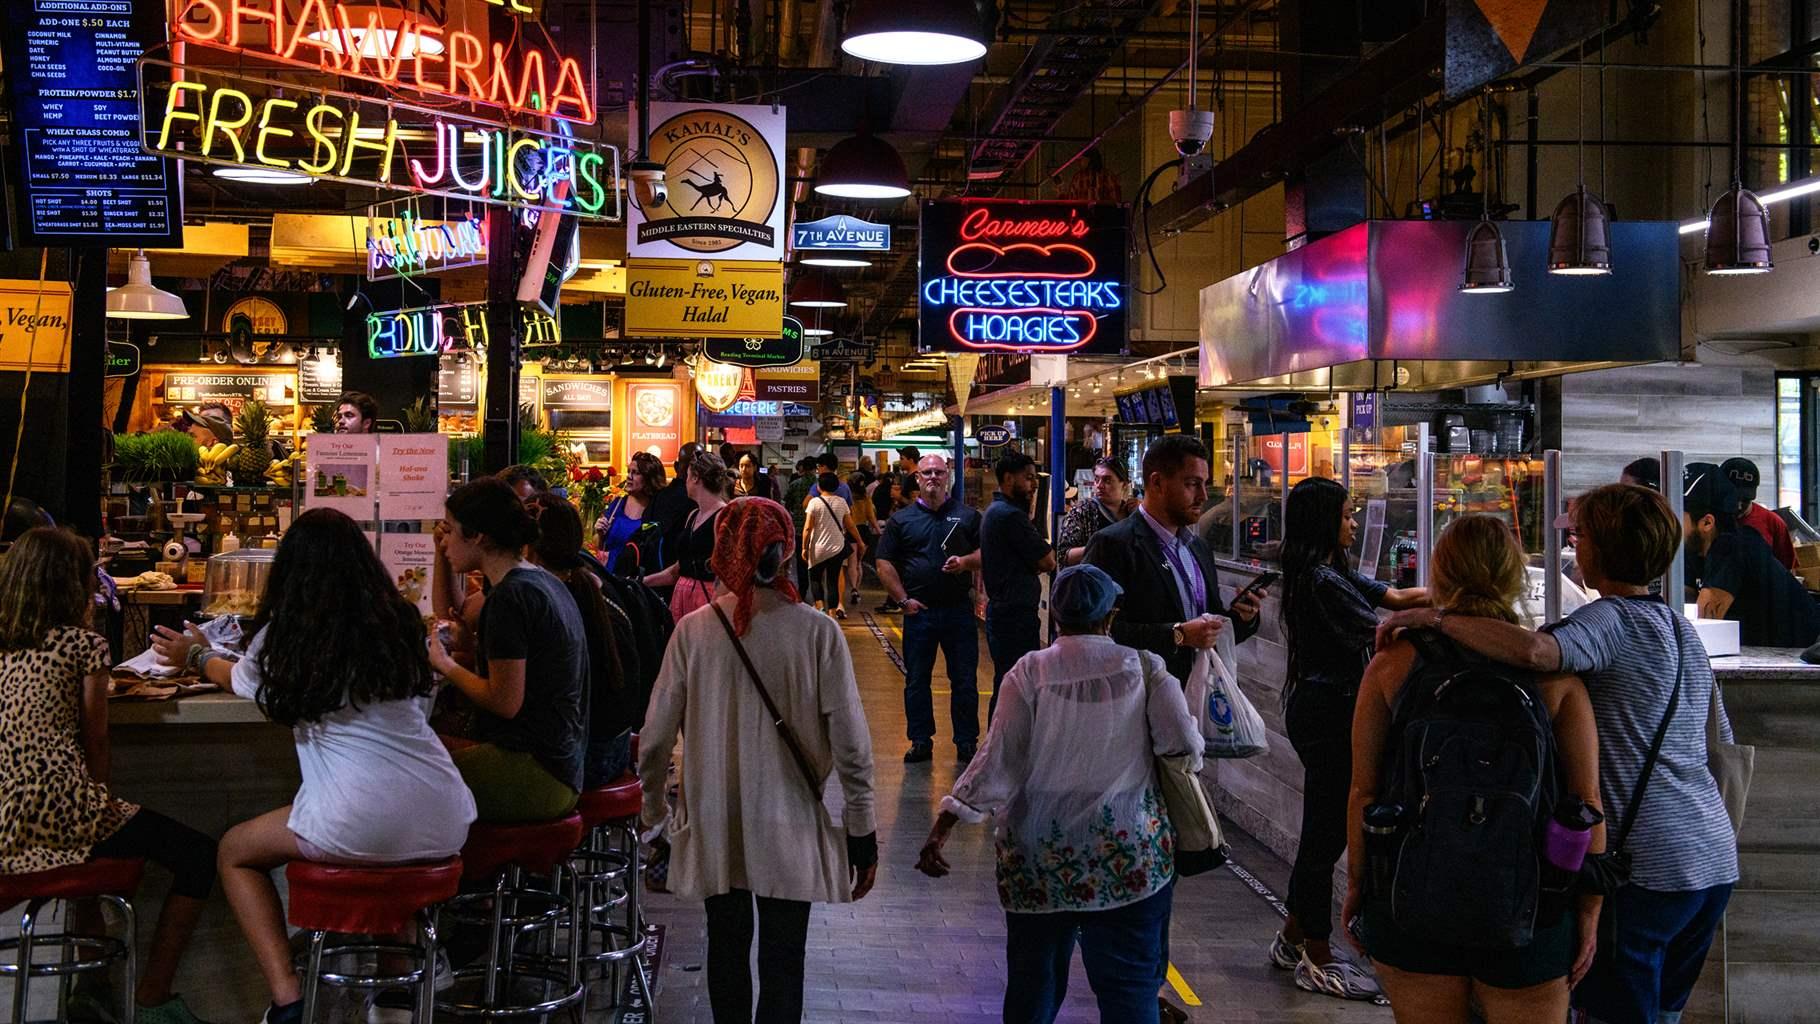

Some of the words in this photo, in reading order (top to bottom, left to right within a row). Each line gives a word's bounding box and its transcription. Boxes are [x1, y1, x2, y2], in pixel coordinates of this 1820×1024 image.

[40, 2, 89, 10] ADDITIONAL
[39, 18, 80, 26] ADD-ONE
[82, 18, 104, 27] $.50
[106, 20, 130, 28] EACH
[179, 0, 592, 121] SHAWERMA
[39, 89, 117, 98] PROTEIN/POWDER
[118, 90, 137, 99] $1.7
[157, 82, 398, 182] FRESH
[664, 121, 751, 146] KAMAL'S
[410, 121, 605, 211] JUICES
[640, 224, 676, 239] MIDDLE
[677, 222, 717, 232] EASTERN
[718, 224, 772, 241] SPECIALTIES
[961, 208, 1089, 240] Carmen's
[827, 231, 884, 243] AVENUE
[630, 280, 727, 301] Gluten-Free,
[731, 283, 780, 305] Vegan,
[925, 278, 1120, 308] CHEESESTEAKS
[8, 307, 67, 333] Vegan,
[681, 306, 728, 324] Halal
[968, 314, 1080, 343] HOAGIES
[832, 347, 870, 356] AVENUE
[173, 376, 234, 386] PRE-ORDER
[546, 382, 608, 397] SANDWICHES
[767, 385, 807, 394] PASTRIES
[720, 401, 777, 414] REPERIE
[632, 432, 677, 440] FLATBREAD
